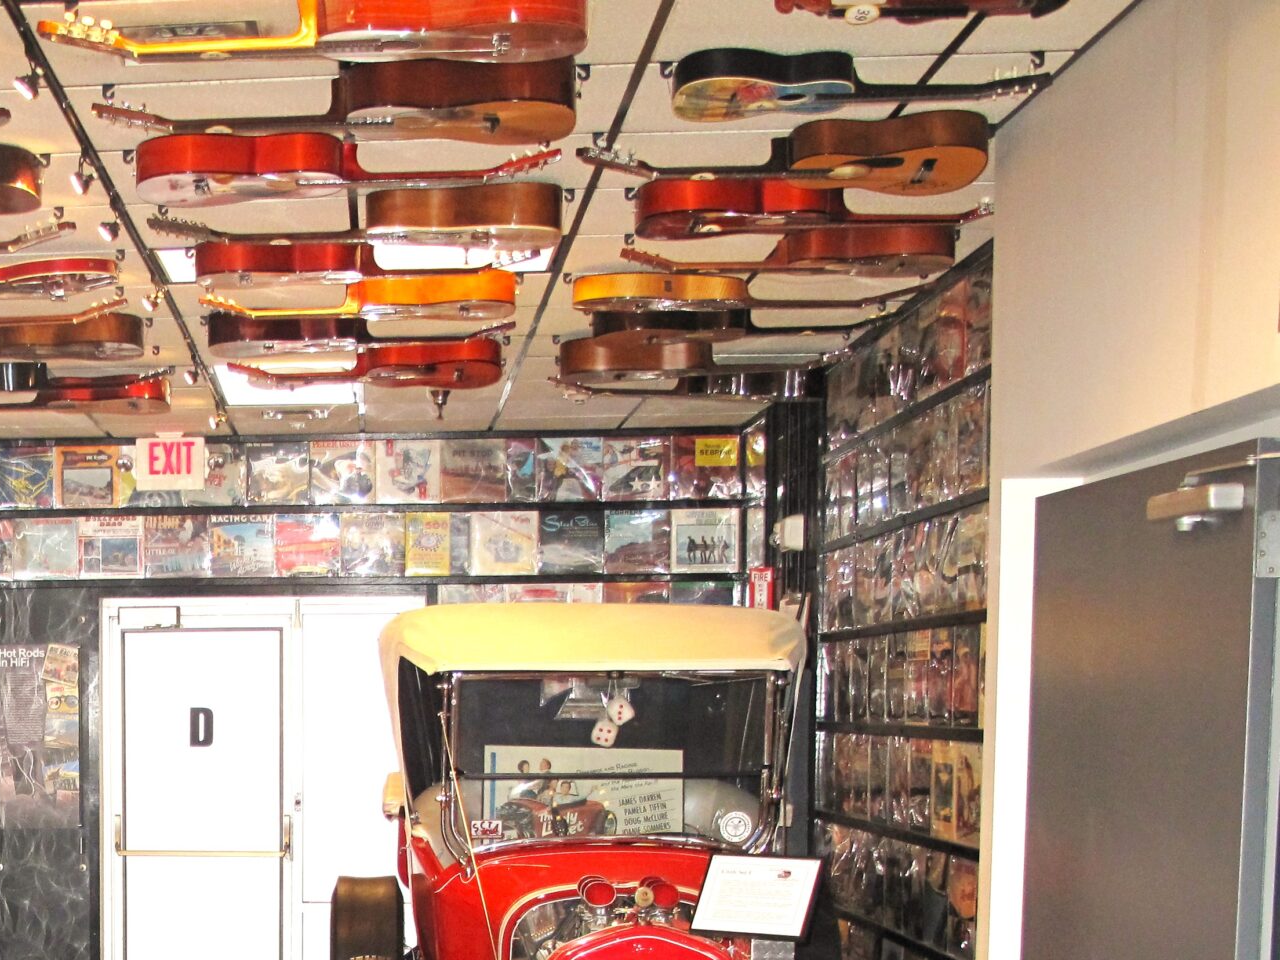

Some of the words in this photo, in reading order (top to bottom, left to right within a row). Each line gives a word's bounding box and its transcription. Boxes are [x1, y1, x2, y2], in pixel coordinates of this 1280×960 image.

[148, 441, 195, 475] EXIT
[753, 573, 769, 582] FIRE
[18, 648, 45, 659] Rods
[190, 707, 213, 745] D
[624, 806, 648, 816] PAMELA
[624, 817, 641, 826] DOUG
